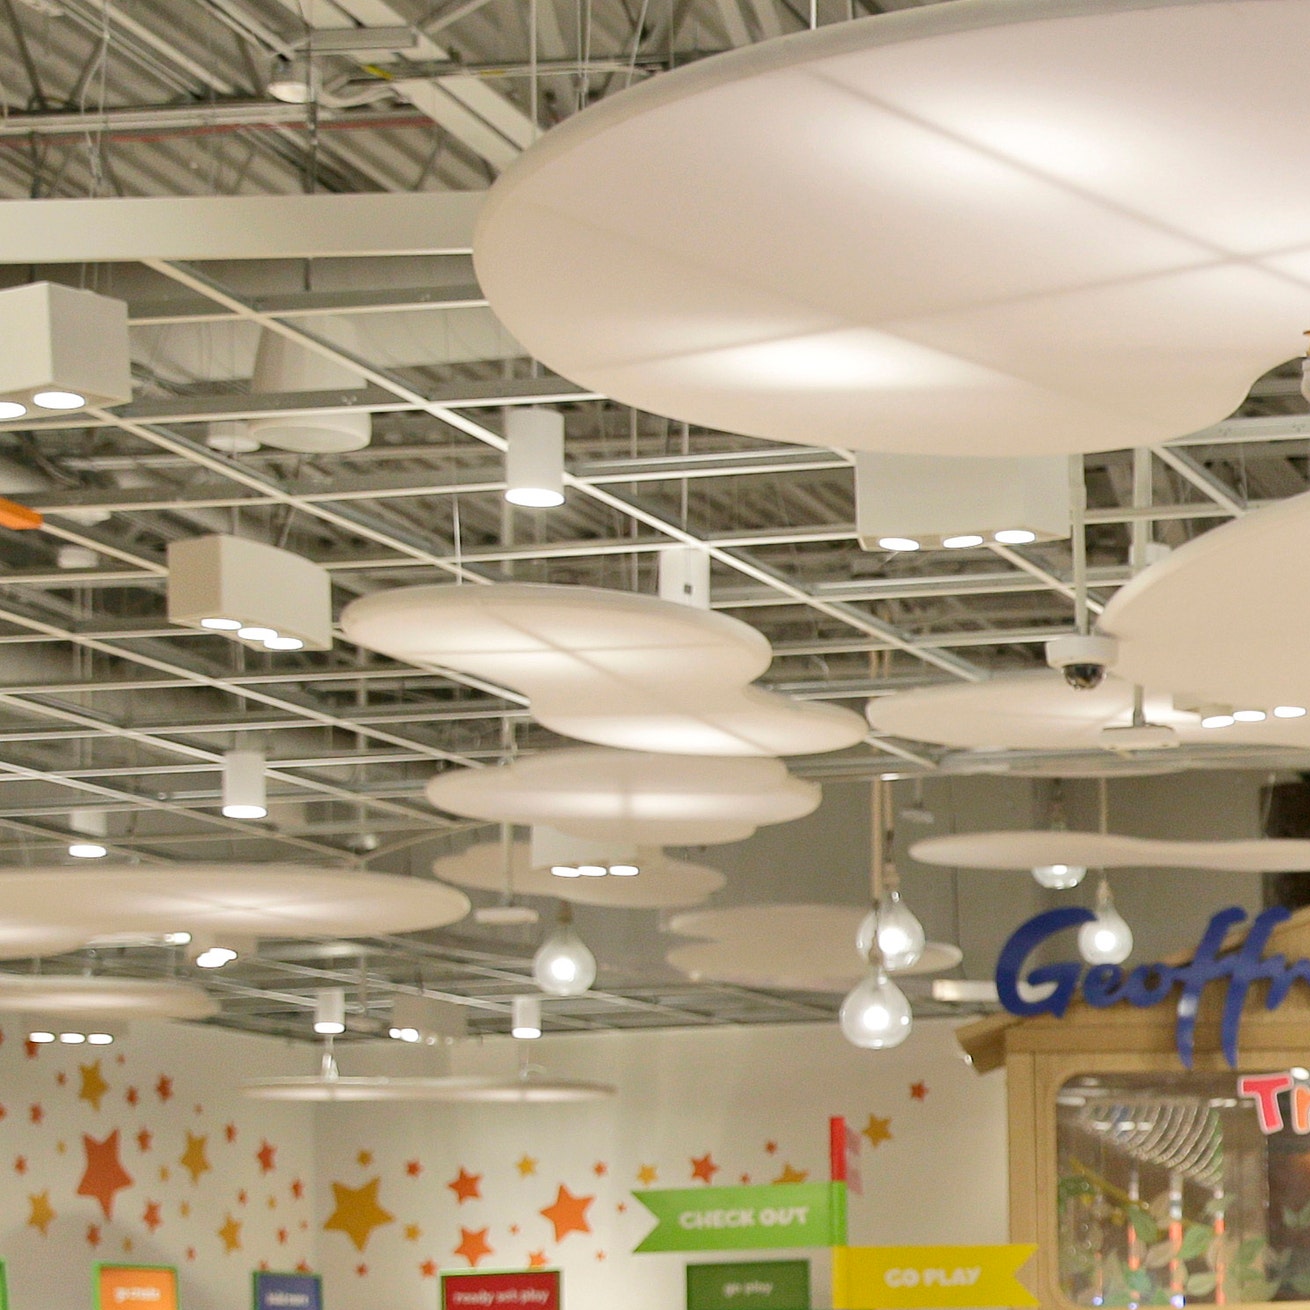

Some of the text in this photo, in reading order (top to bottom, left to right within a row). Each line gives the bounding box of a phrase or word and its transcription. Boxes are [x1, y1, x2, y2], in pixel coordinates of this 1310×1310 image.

[678, 1206, 811, 1230] CHECK OUT
[884, 1266, 982, 1288] GO PLAY
